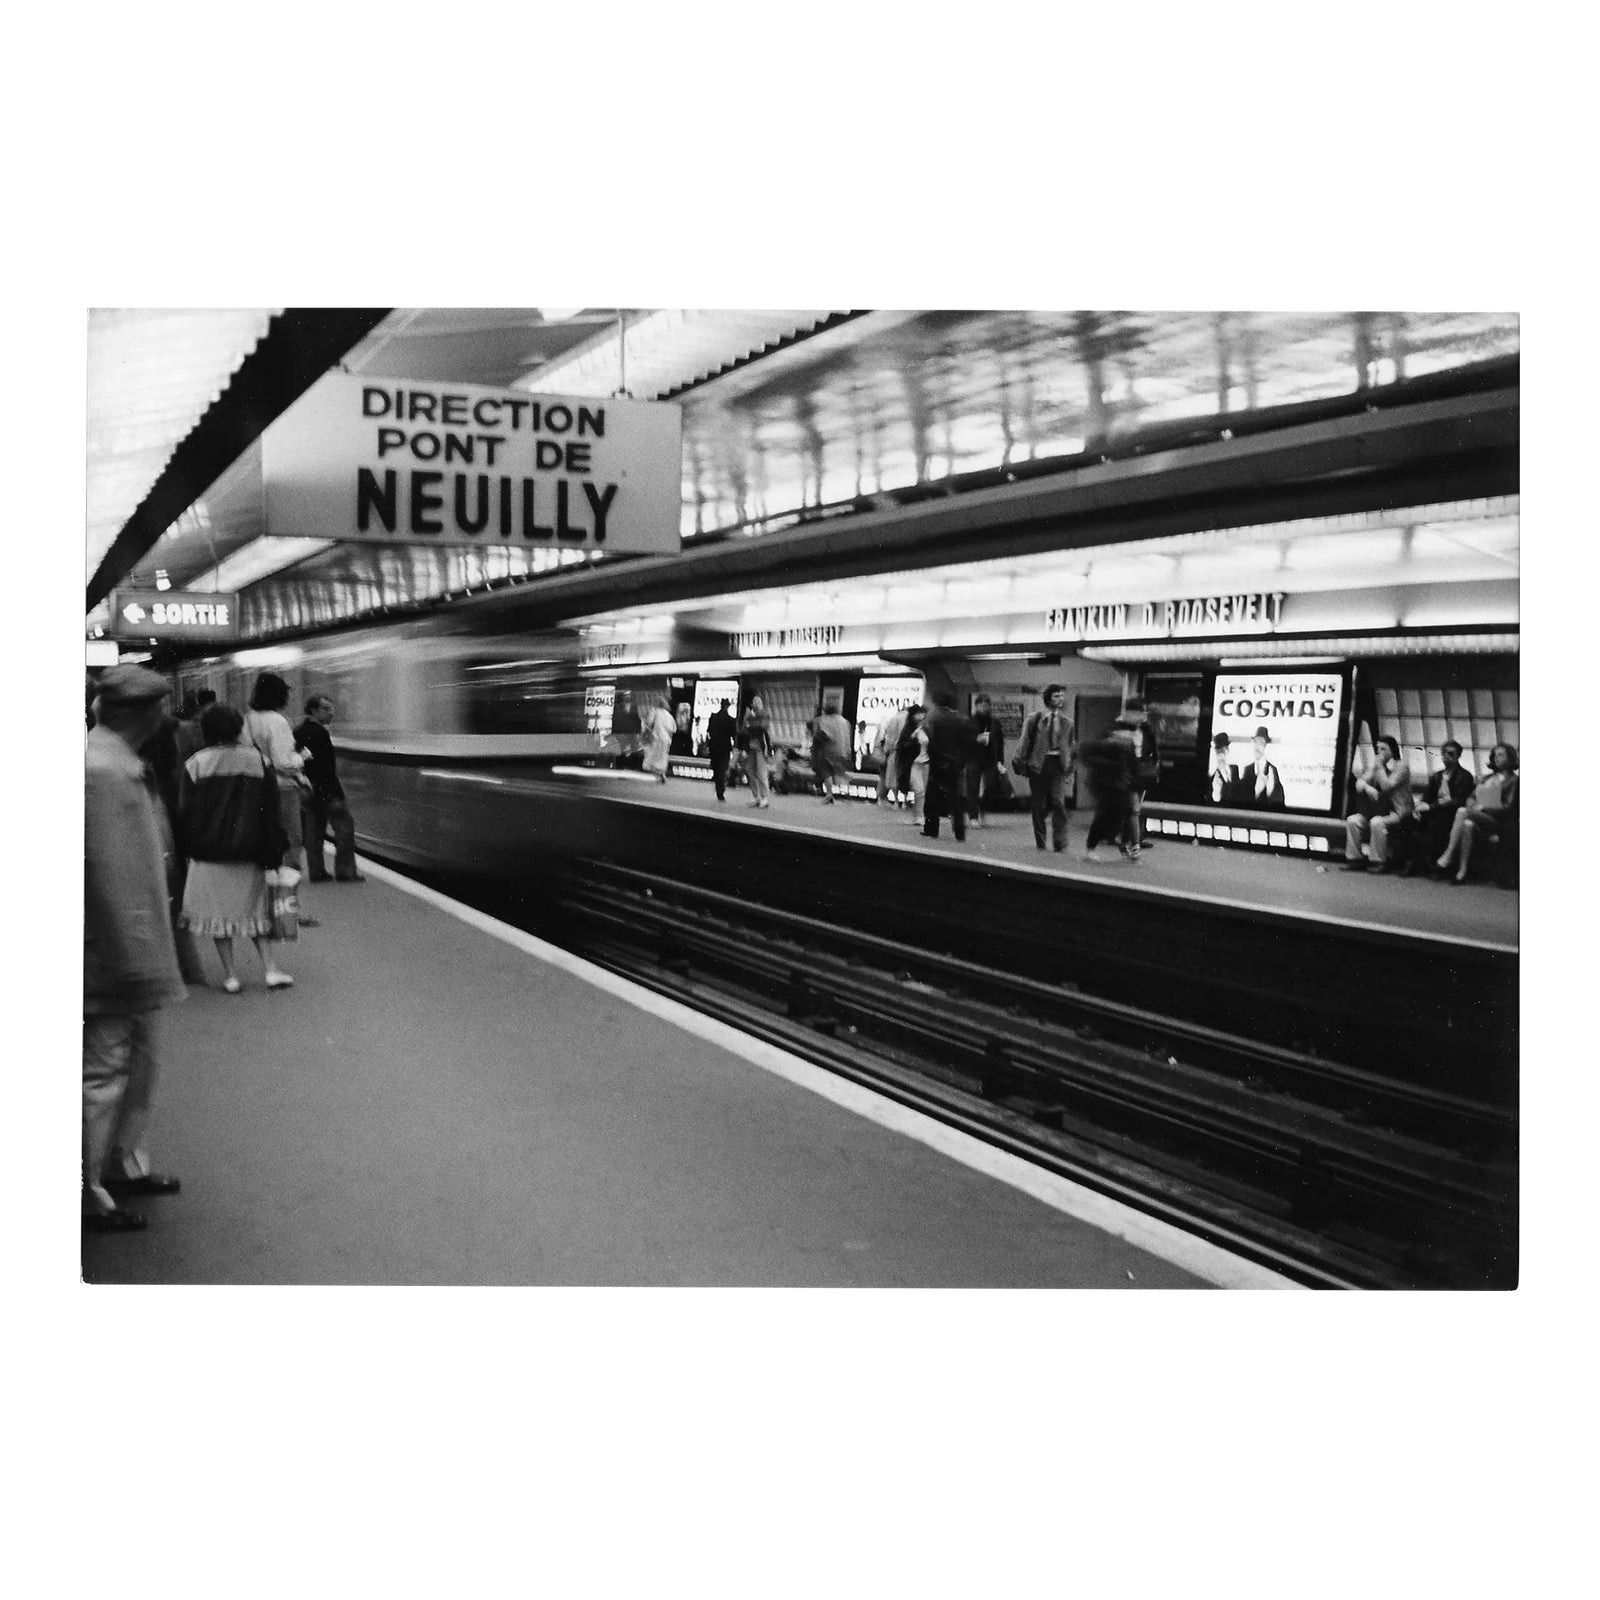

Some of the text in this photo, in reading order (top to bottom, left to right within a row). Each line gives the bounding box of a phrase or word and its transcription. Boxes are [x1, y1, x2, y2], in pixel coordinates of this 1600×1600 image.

[362, 387, 605, 437] DIRECTION
[378, 427, 591, 473] PONT DE
[357, 467, 618, 542] NEUILLY
[152, 603, 229, 625] SORTIE
[1045, 603, 1129, 632] FRANKLIN
[1164, 592, 1286, 631] ROOSEVELT
[1219, 699, 1334, 718] COSMAS
[1221, 683, 1337, 694] LES OPTICIENS
